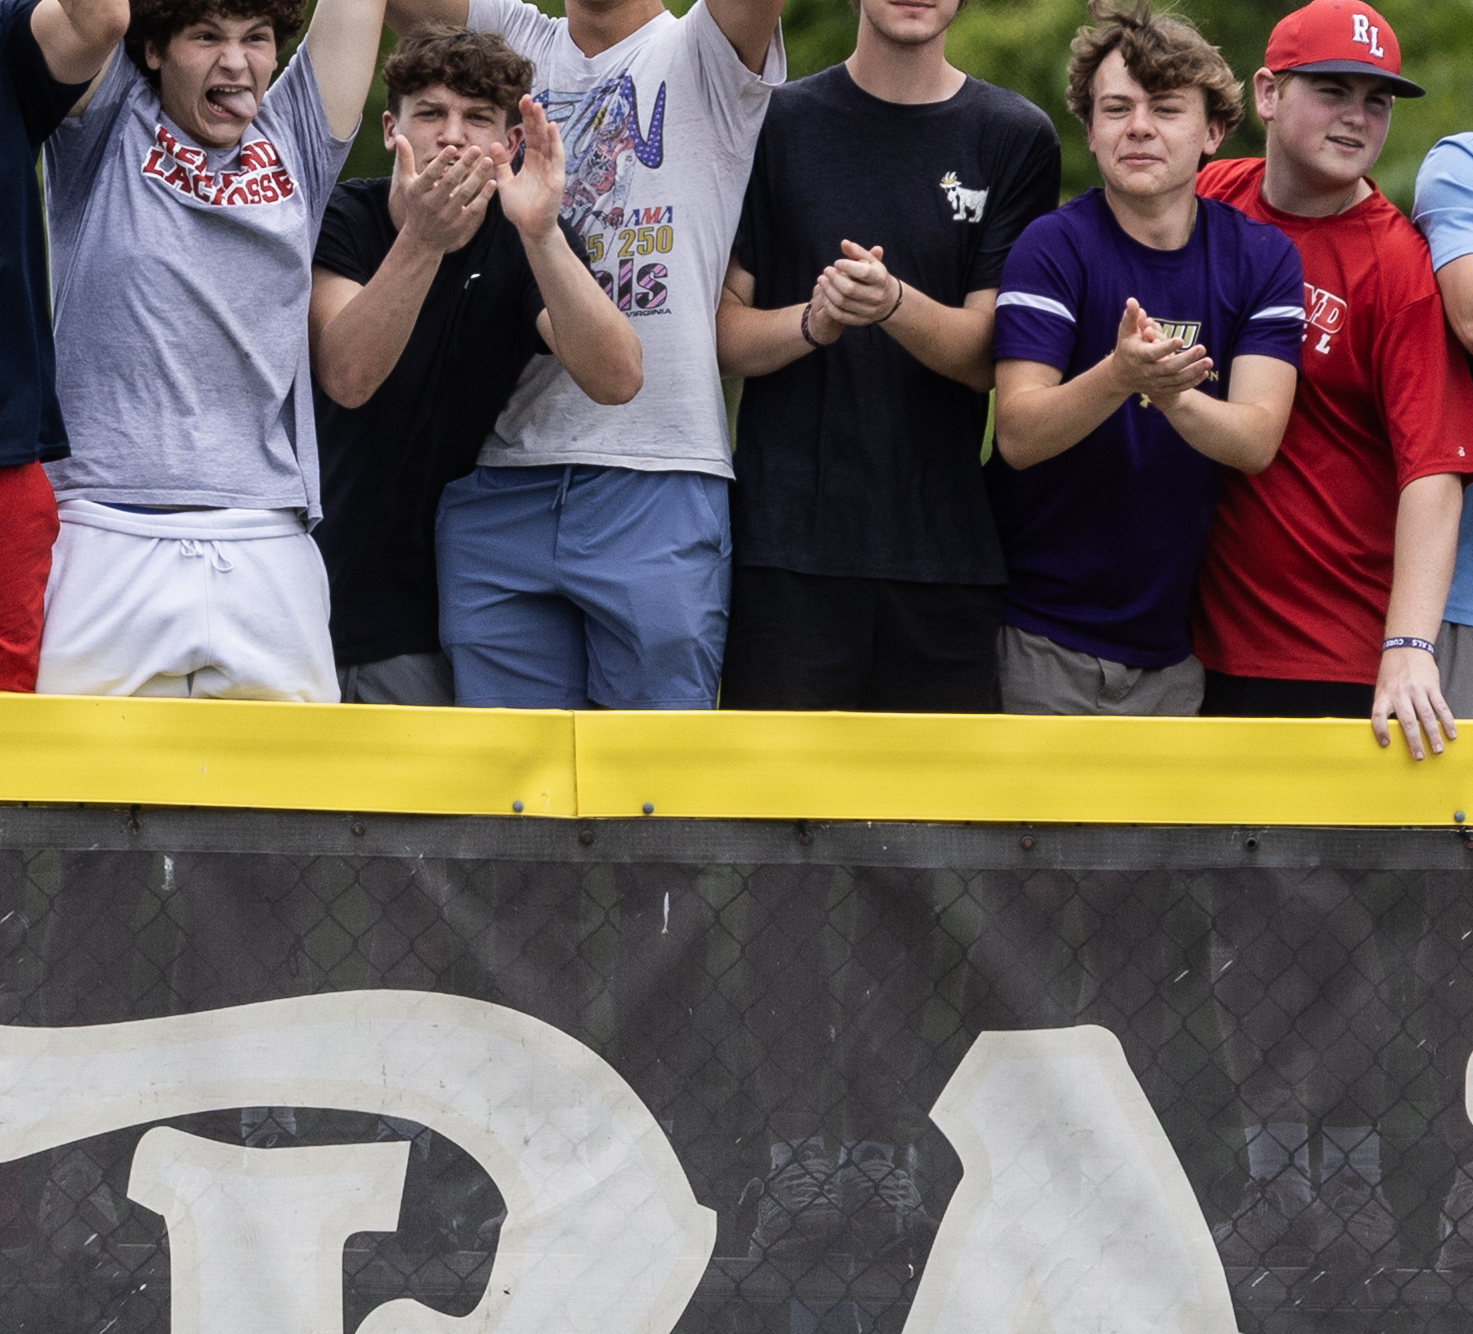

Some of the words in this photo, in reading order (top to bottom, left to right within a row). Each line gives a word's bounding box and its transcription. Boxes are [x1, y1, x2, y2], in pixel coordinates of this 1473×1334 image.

[1351, 14, 1384, 58] RL
[141, 146, 299, 207] LACROSSE
[624, 205, 673, 227] AMA
[625, 307, 672, 318] VIRGINIA
